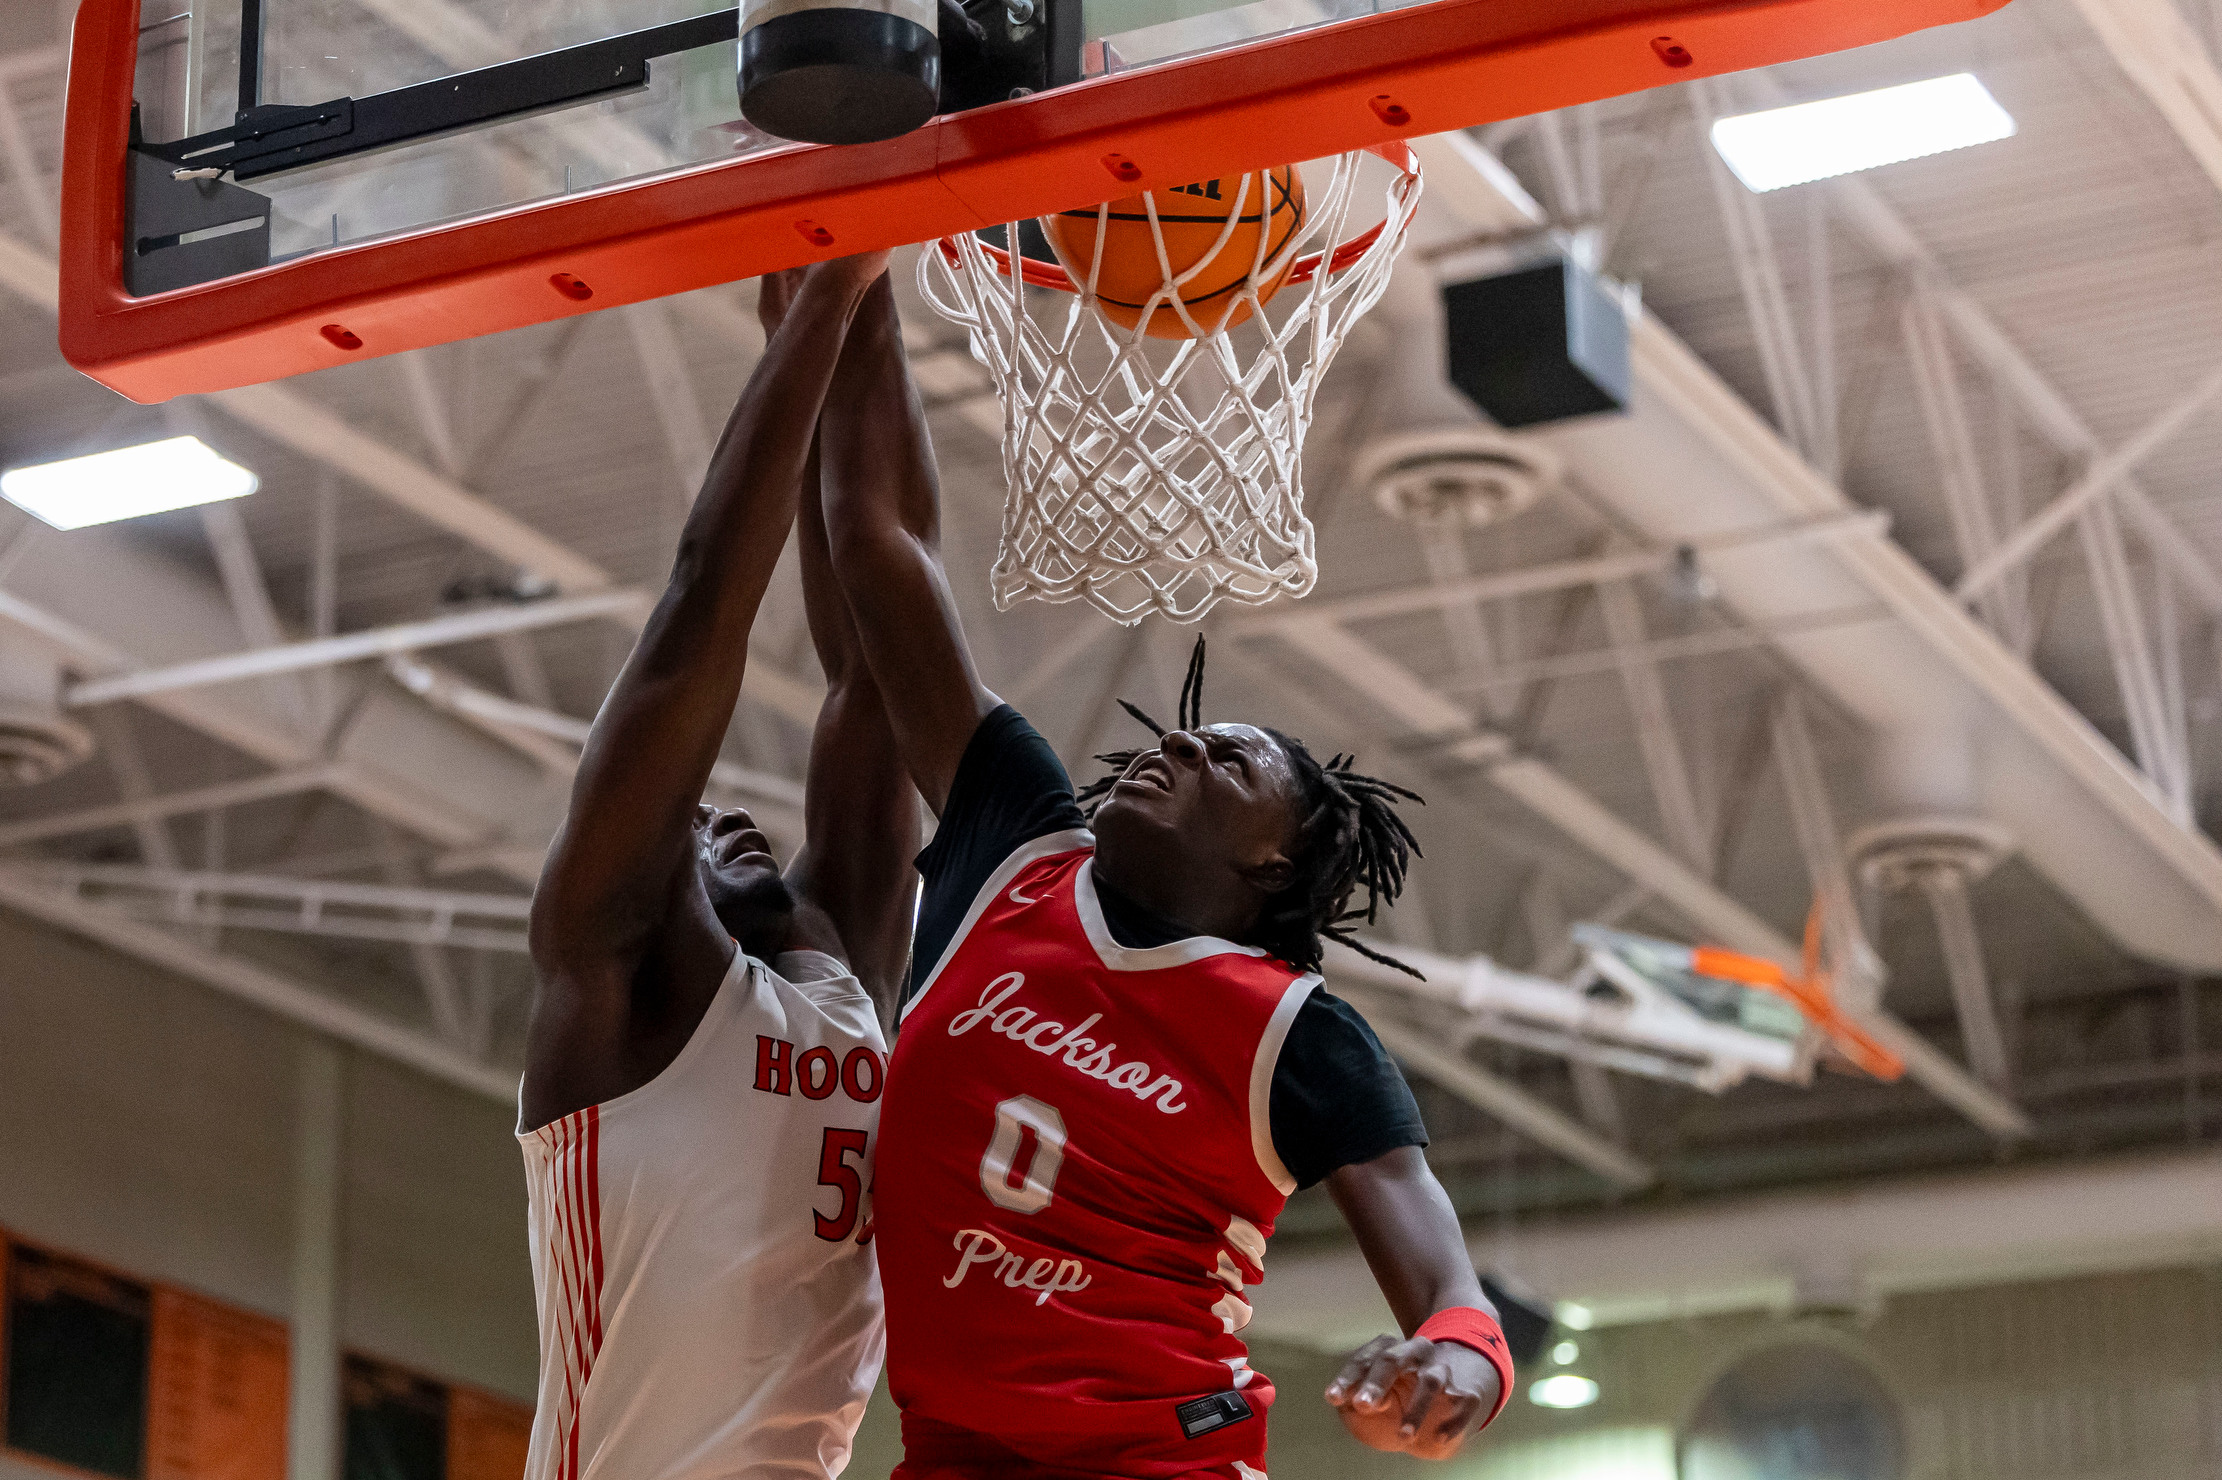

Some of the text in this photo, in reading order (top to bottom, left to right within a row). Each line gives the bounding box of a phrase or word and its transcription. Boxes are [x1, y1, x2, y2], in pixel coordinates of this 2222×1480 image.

[753, 1034, 889, 1103] HOO
[948, 971, 1187, 1114] Jackson
[979, 1093, 1069, 1215] 0
[943, 1229, 1092, 1306] Prep
[1227, 1400, 1238, 1412] L
